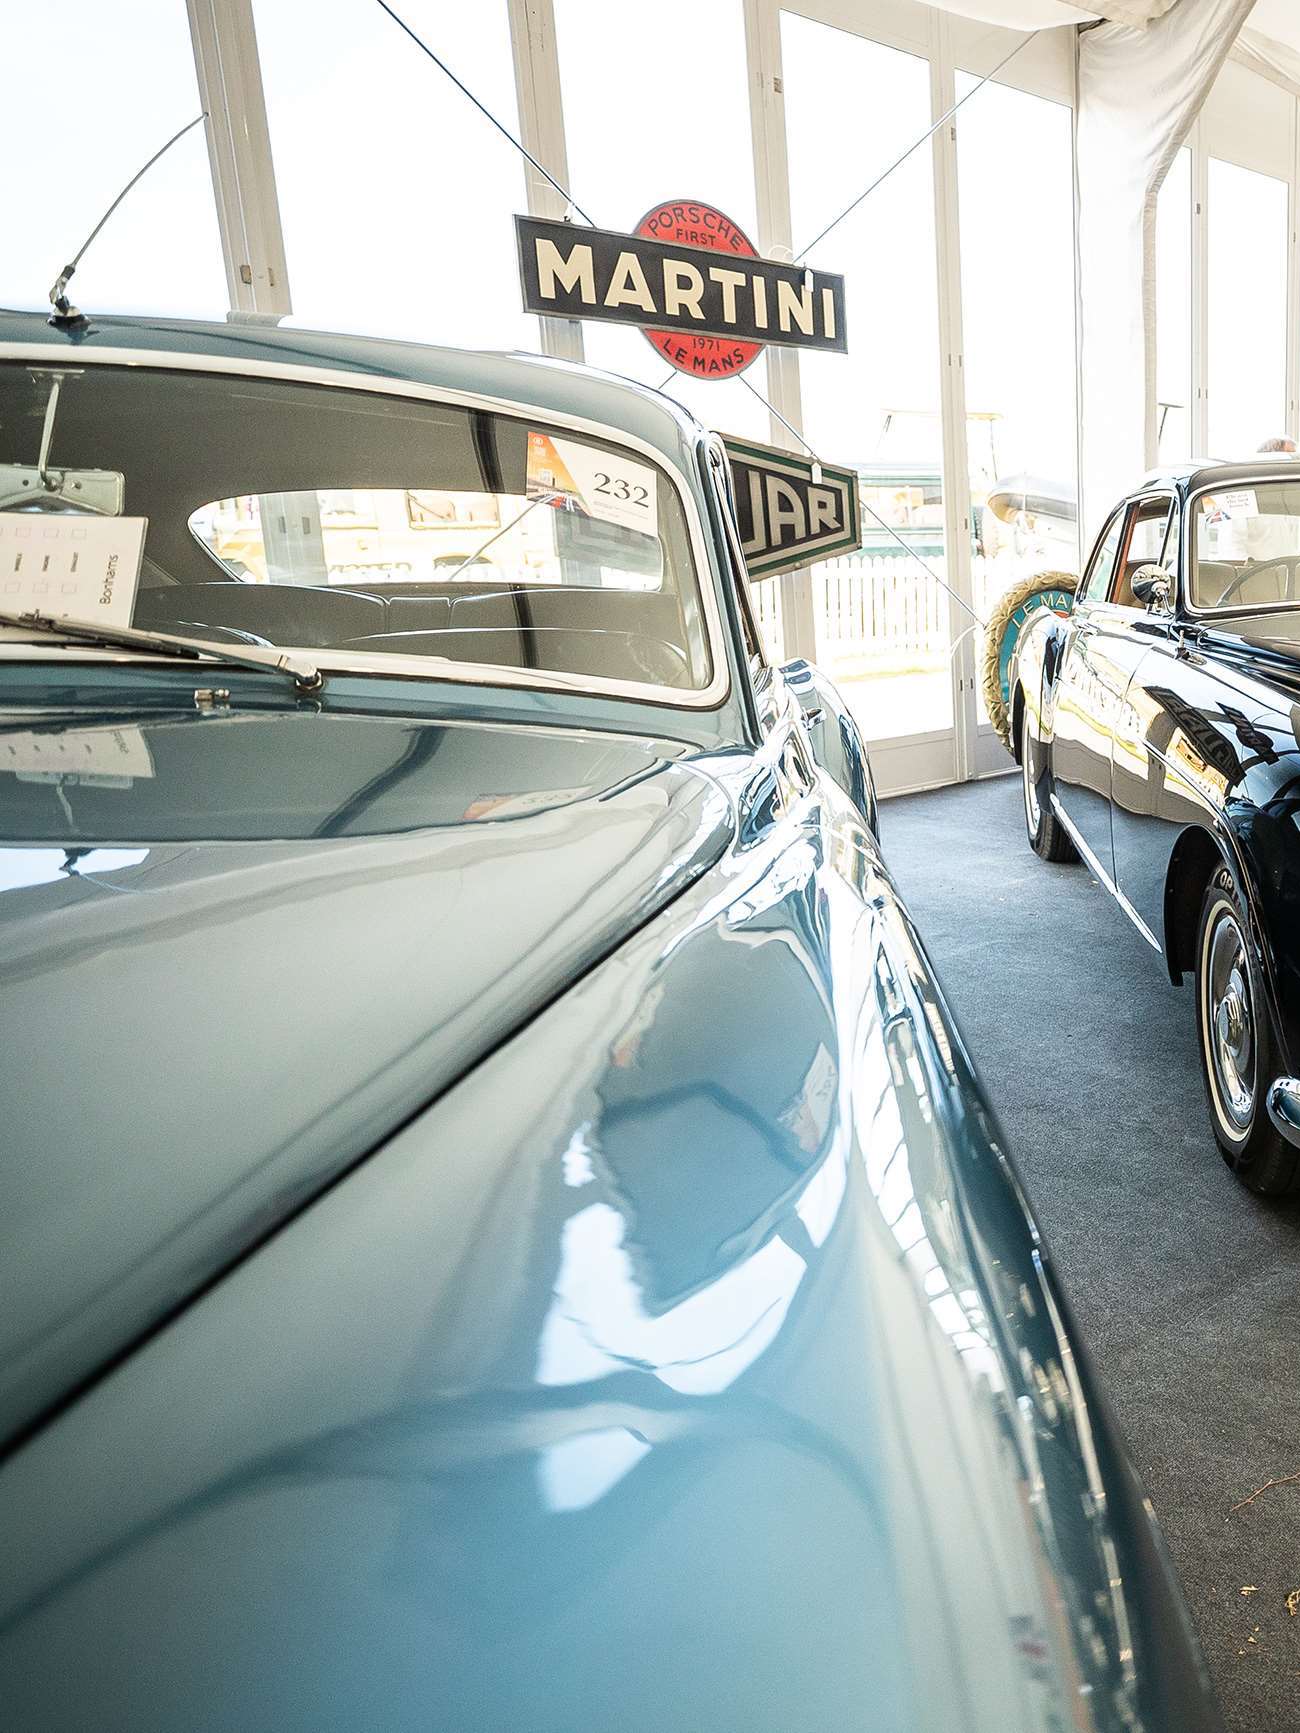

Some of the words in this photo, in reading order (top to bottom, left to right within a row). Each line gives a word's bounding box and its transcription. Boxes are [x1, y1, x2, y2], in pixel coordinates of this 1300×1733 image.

[648, 207, 743, 251] PORSCHE
[676, 228, 716, 246] FIRST
[535, 238, 836, 338] MARTINI
[662, 338, 687, 364] LE
[693, 347, 744, 372] MANS
[693, 338, 720, 352] 1971
[593, 472, 649, 509] 232
[99, 554, 119, 604] Bonhams
